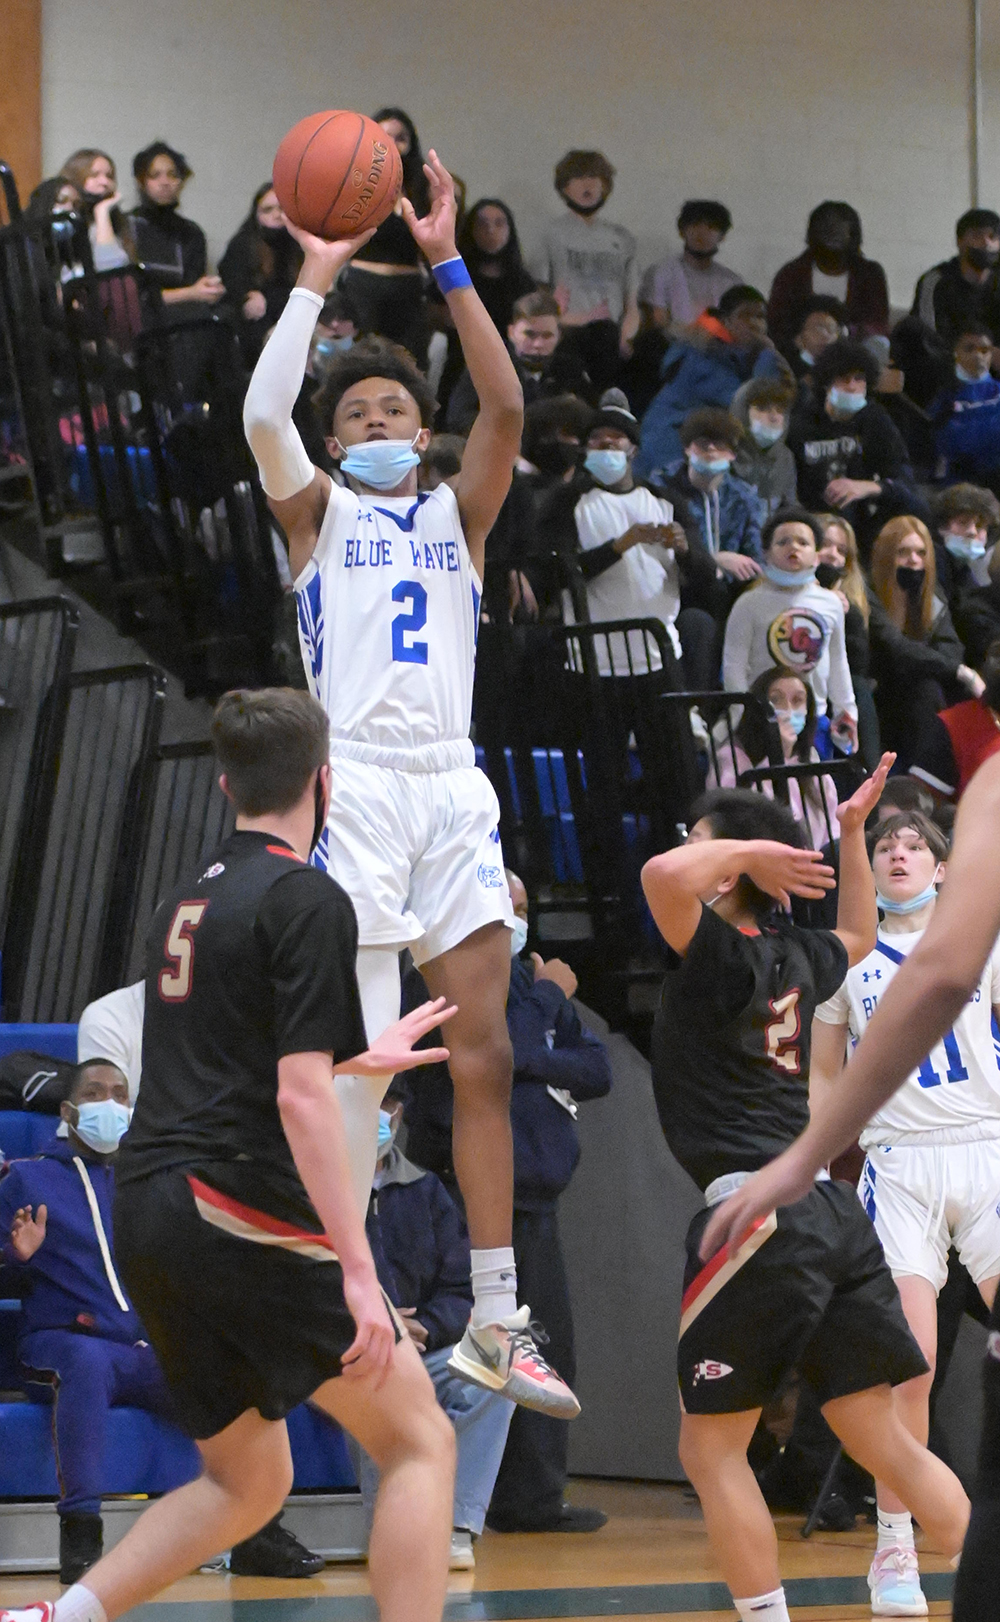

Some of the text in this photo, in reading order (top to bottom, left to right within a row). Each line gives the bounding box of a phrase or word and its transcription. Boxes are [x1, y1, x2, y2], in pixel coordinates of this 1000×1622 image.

[341, 140, 388, 221] SPALDING
[344, 539, 461, 572] BLUE WAVE
[391, 580, 428, 665] 2
[158, 898, 210, 1003] 5
[765, 986, 800, 1075] 2
[706, 1364, 721, 1376] S
